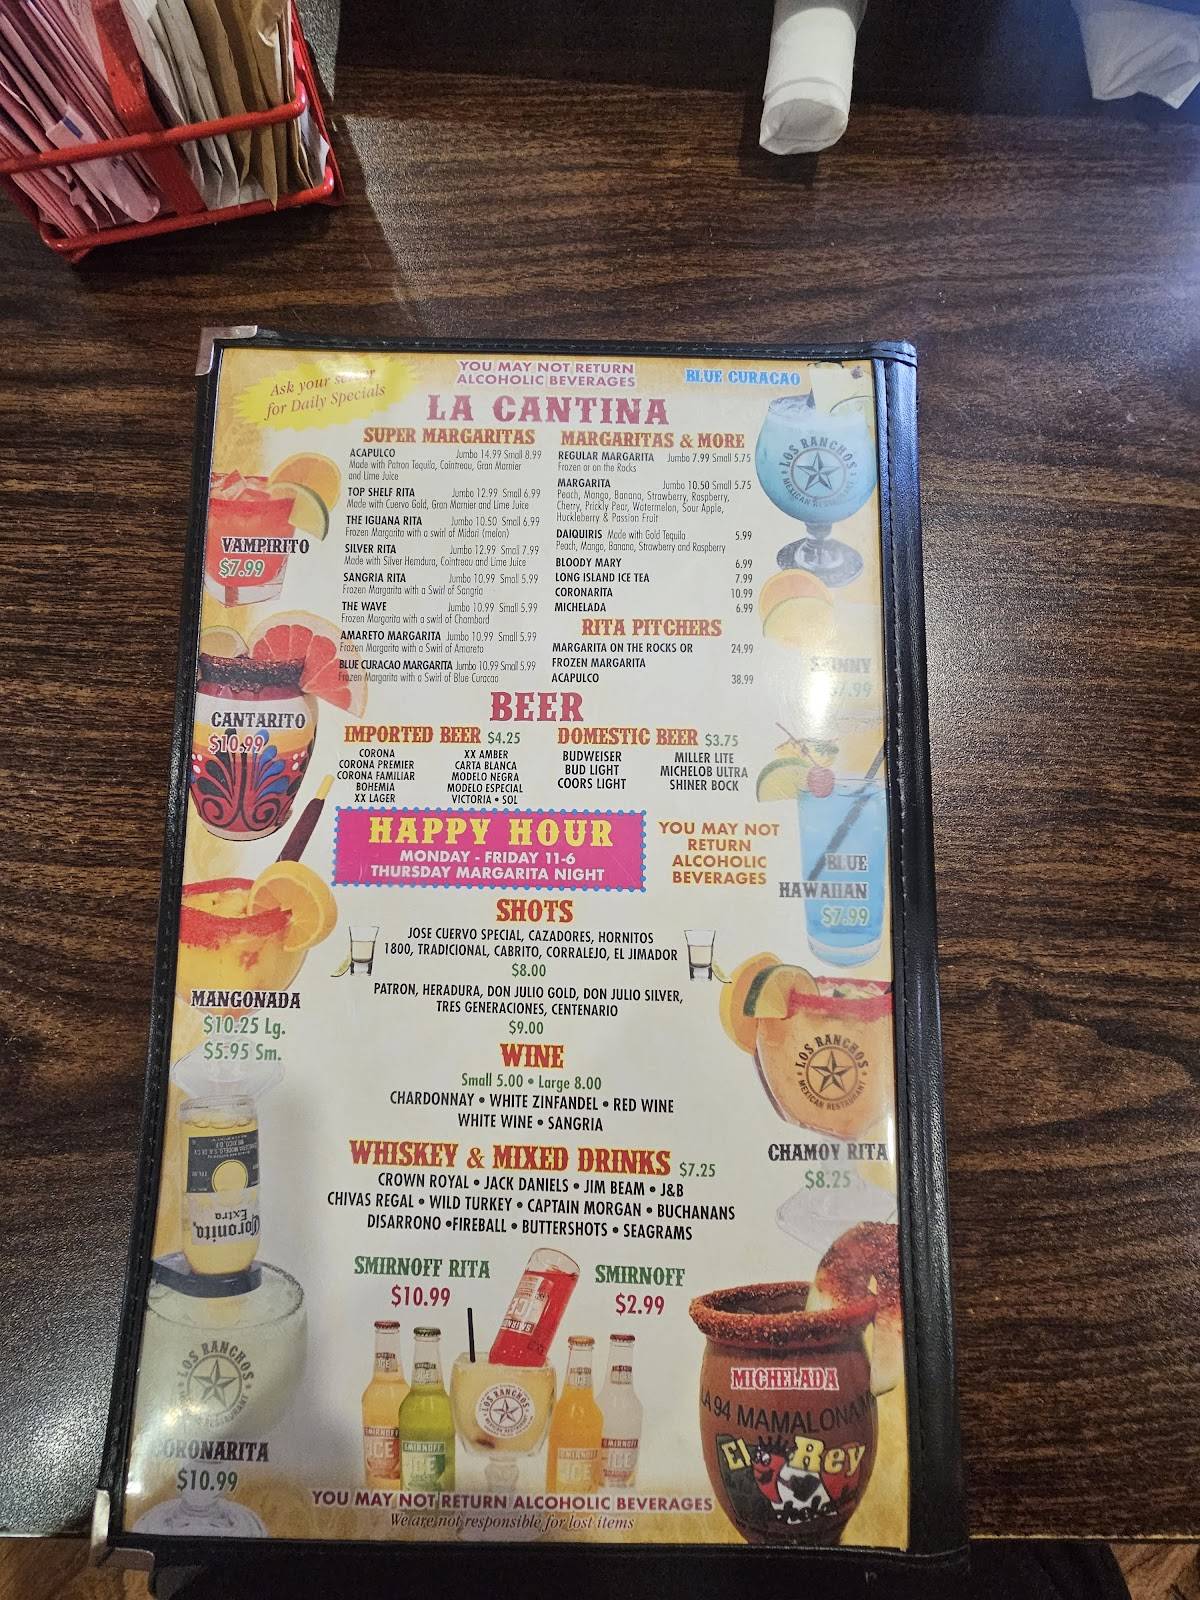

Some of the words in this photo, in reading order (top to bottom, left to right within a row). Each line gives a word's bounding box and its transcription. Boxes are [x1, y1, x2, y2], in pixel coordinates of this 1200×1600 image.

[460, 361, 492, 372] YOU
[497, 361, 533, 372] MAY
[538, 362, 570, 373] NOT
[575, 363, 634, 374] RETURN
[457, 374, 545, 386] ALCOHOLIC
[550, 375, 636, 387] BEVERAGES
[685, 368, 722, 383] BLUE
[727, 370, 801, 385] CURACAO
[270, 381, 294, 397] Ask
[297, 378, 330, 394] your
[265, 402, 289, 421] for
[291, 397, 328, 414] Daily
[330, 384, 386, 408] Specials
[427, 395, 474, 421] LA
[492, 395, 670, 425] CANTINA
[364, 427, 416, 443] SUPER
[423, 428, 535, 444] MARGARITAS
[561, 431, 674, 448] MARGARITAS
[680, 434, 693, 448] &
[698, 433, 744, 448] MORE
[350, 449, 395, 457] ACAPULCO
[457, 449, 477, 458] Jumbo
[482, 450, 501, 459] 14.99
[504, 449, 522, 459] Small
[525, 450, 541, 459] 8.99
[559, 451, 597, 460] REGULAR
[602, 452, 653, 461] MARGARITA
[669, 453, 690, 462] Jumbo
[693, 453, 709, 462] 7.99
[713, 453, 731, 462] Small
[735, 453, 750, 462] 5.75
[349, 488, 365, 496] TOP
[369, 488, 392, 496] SHELF
[396, 488, 414, 496] RITA
[221, 537, 310, 554] VAMPIRITO
[219, 560, 265, 576] $7.99
[556, 558, 591, 567] BLOODY
[595, 558, 621, 567] MARY
[736, 559, 752, 568] 6.99
[556, 573, 579, 581] LONG
[584, 573, 614, 582] ISLAND
[619, 573, 630, 582] ICE
[634, 573, 649, 582] TEA
[736, 574, 752, 583] 7.99
[555, 588, 612, 596] CORONARITA
[732, 589, 752, 598] 10.99
[582, 619, 625, 635] RITA
[632, 619, 722, 636] PITCHERS
[340, 660, 358, 669] BLUE
[361, 660, 400, 669] CURACAO
[403, 661, 452, 670] MARGARITA
[490, 692, 583, 721] BEER
[211, 711, 306, 728] CANTARITO
[344, 726, 433, 743] IMPORTED
[440, 727, 481, 743] BEER
[488, 731, 520, 744] $4.25
[558, 728, 650, 745] DOMESTIC
[656, 728, 698, 745] BEER
[705, 733, 738, 747] $3.75
[208, 735, 264, 753] $10.99
[360, 749, 394, 757] CORONA
[455, 761, 480, 769] CARTA
[485, 761, 516, 770] BLANCA
[566, 765, 585, 775] BUD
[590, 765, 618, 775] LIGHT
[670, 780, 706, 790] SHINER
[712, 780, 738, 791] BOCK
[369, 817, 491, 845] HAPPY
[508, 817, 613, 846] HOUR
[659, 822, 694, 834] YOU
[702, 823, 737, 835] MAY
[745, 824, 779, 836] NOT
[688, 839, 750, 851] RETURN
[399, 850, 470, 863] MONDAY
[484, 853, 542, 864] FRIDAY
[545, 853, 576, 865] 11-6
[673, 855, 766, 868] ALCOHOLIC
[826, 855, 868, 872] BLUE
[371, 864, 451, 878] THURSDAY
[456, 868, 548, 881] MARGARITA
[554, 868, 605, 881] NIGHT
[673, 871, 766, 884] BEVERAGES
[779, 882, 868, 899] HAWAIIAN
[497, 897, 573, 922] SHOTS
[822, 907, 869, 925] $7.99
[409, 928, 431, 938] JOSE
[436, 928, 476, 939] CUERVO
[481, 929, 525, 942] SPECIAL,
[529, 930, 594, 943] CAZADORES,
[599, 932, 653, 943] HORNITOS
[512, 964, 546, 976] $8.00
[191, 990, 301, 1009] MANGONADA
[203, 1016, 259, 1035] $10.25
[264, 1016, 286, 1039] Lg.
[509, 1021, 543, 1034] $9.00
[203, 1043, 250, 1060] $5.95
[255, 1044, 282, 1061] Sm.
[500, 1044, 563, 1068] WINE
[795, 1043, 815, 1069] LOS
[814, 1033, 869, 1069] RANCHOS
[462, 1073, 491, 1086] Small
[498, 1074, 523, 1087] 5.00
[539, 1075, 569, 1093] Large
[575, 1076, 601, 1090] 8.00
[391, 1091, 474, 1106] CHARDONNAY
[490, 1094, 527, 1107] WHITE
[533, 1096, 598, 1110] ZINFANDEL
[614, 1098, 636, 1111] RED
[641, 1099, 673, 1113] WINE
[349, 1140, 458, 1168] WHISKEY
[467, 1148, 484, 1168] &
[493, 1145, 568, 1171] MIXED
[578, 1148, 670, 1176] DRINKS
[680, 1163, 715, 1177] $7.25
[768, 1143, 842, 1161] CHAMOY
[848, 1144, 889, 1161] RITA
[379, 1173, 424, 1187] CROWN
[430, 1175, 468, 1188] ROYAL
[484, 1176, 513, 1190] JACK
[519, 1178, 568, 1192] DANIELS
[584, 1180, 605, 1194] JIM
[611, 1181, 644, 1195] BEAM
[661, 1183, 683, 1197] J&B
[804, 1170, 851, 1189] $8.25
[214, 1209, 248, 1220] Extra
[355, 1256, 442, 1277] SMIRNOFF
[449, 1260, 490, 1278] RITA
[596, 1265, 685, 1286] SMIRNOFF
[392, 1285, 450, 1306] $10.99
[616, 1294, 664, 1315] $2.99
[731, 1368, 839, 1390] MICHELADA
[722, 1438, 750, 1471] El
[790, 1436, 865, 1476] Rey
[177, 1468, 238, 1493] $10.99
[312, 1490, 349, 1506] YOU
[354, 1491, 394, 1507] MAY
[398, 1492, 436, 1509] NOT
[441, 1493, 508, 1510] RETURN
[513, 1495, 610, 1511] ALCOHOLIC
[617, 1497, 713, 1512] BEVERAGES
[390, 1513, 407, 1527] We
[408, 1516, 435, 1527] are
[438, 1514, 461, 1528] not
[464, 1513, 542, 1532] responsible
[544, 1514, 566, 1532] for
[568, 1515, 593, 1529] lost
[597, 1516, 635, 1530] items
